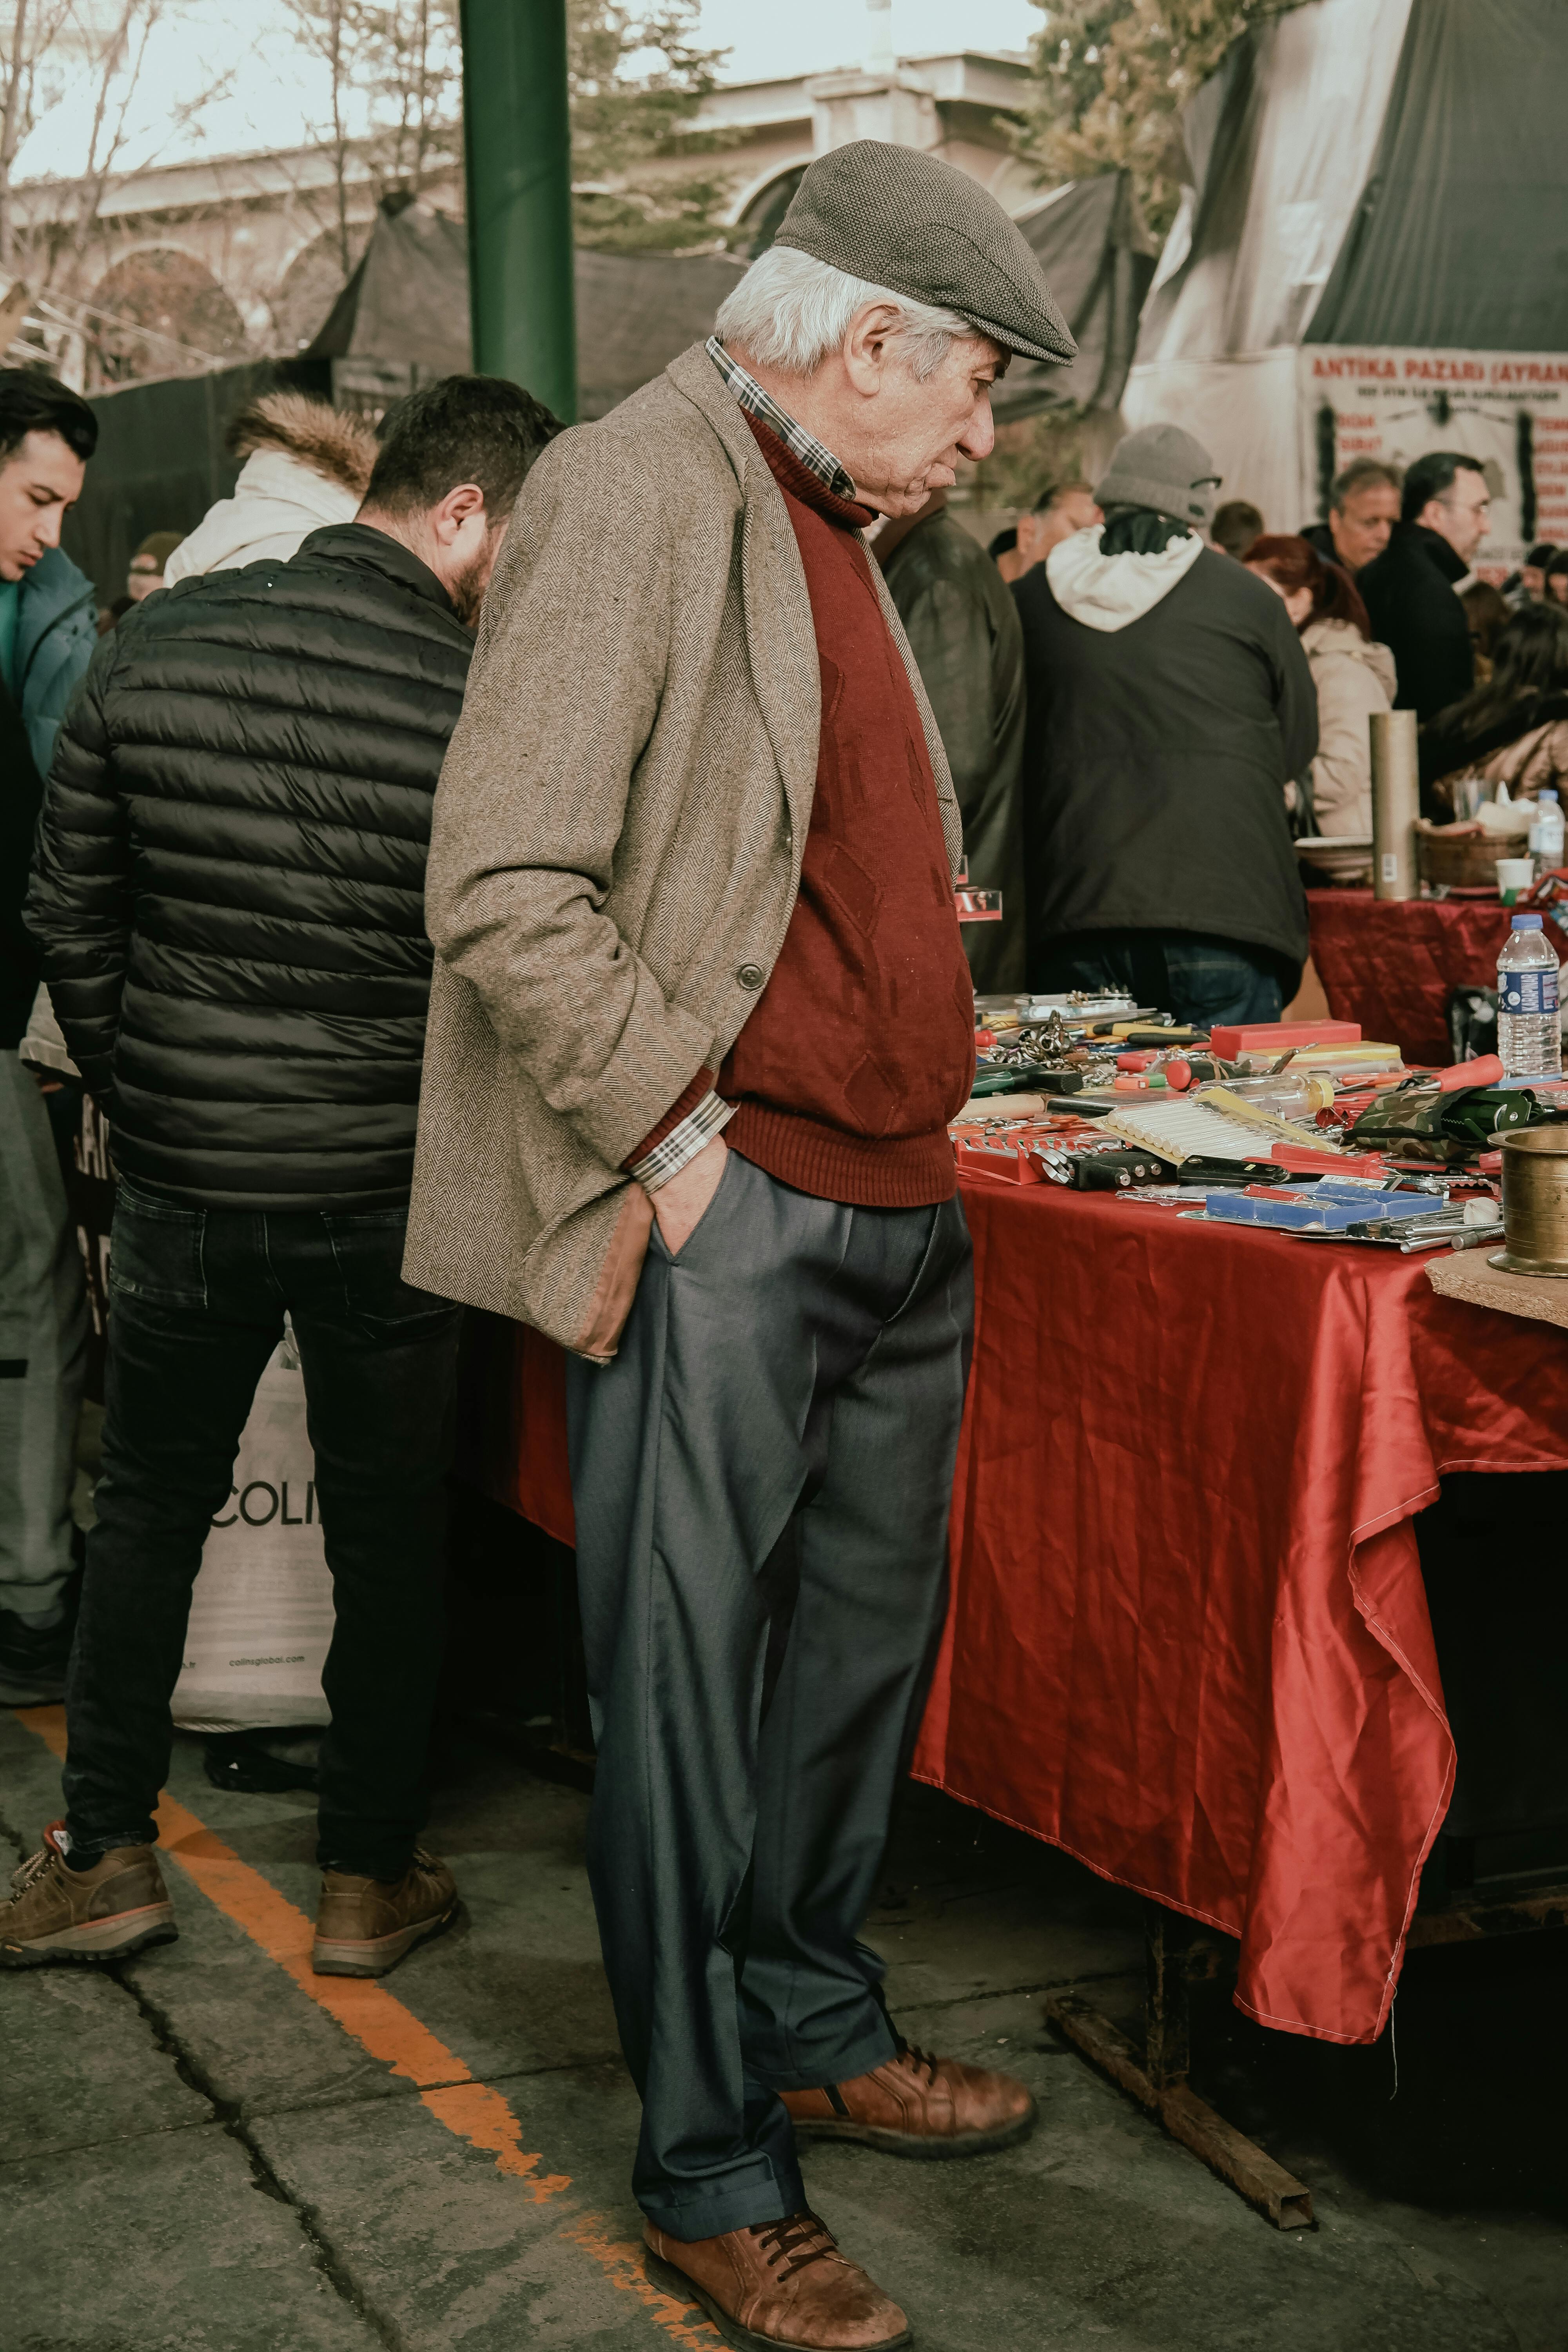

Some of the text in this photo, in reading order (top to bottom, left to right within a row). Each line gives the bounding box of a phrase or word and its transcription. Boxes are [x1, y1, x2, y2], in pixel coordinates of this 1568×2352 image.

[1521, 974, 1539, 1011] KARAPINAR
[211, 1481, 322, 1528] OLI
[229, 1656, 305, 1666] colinsglobal.com
